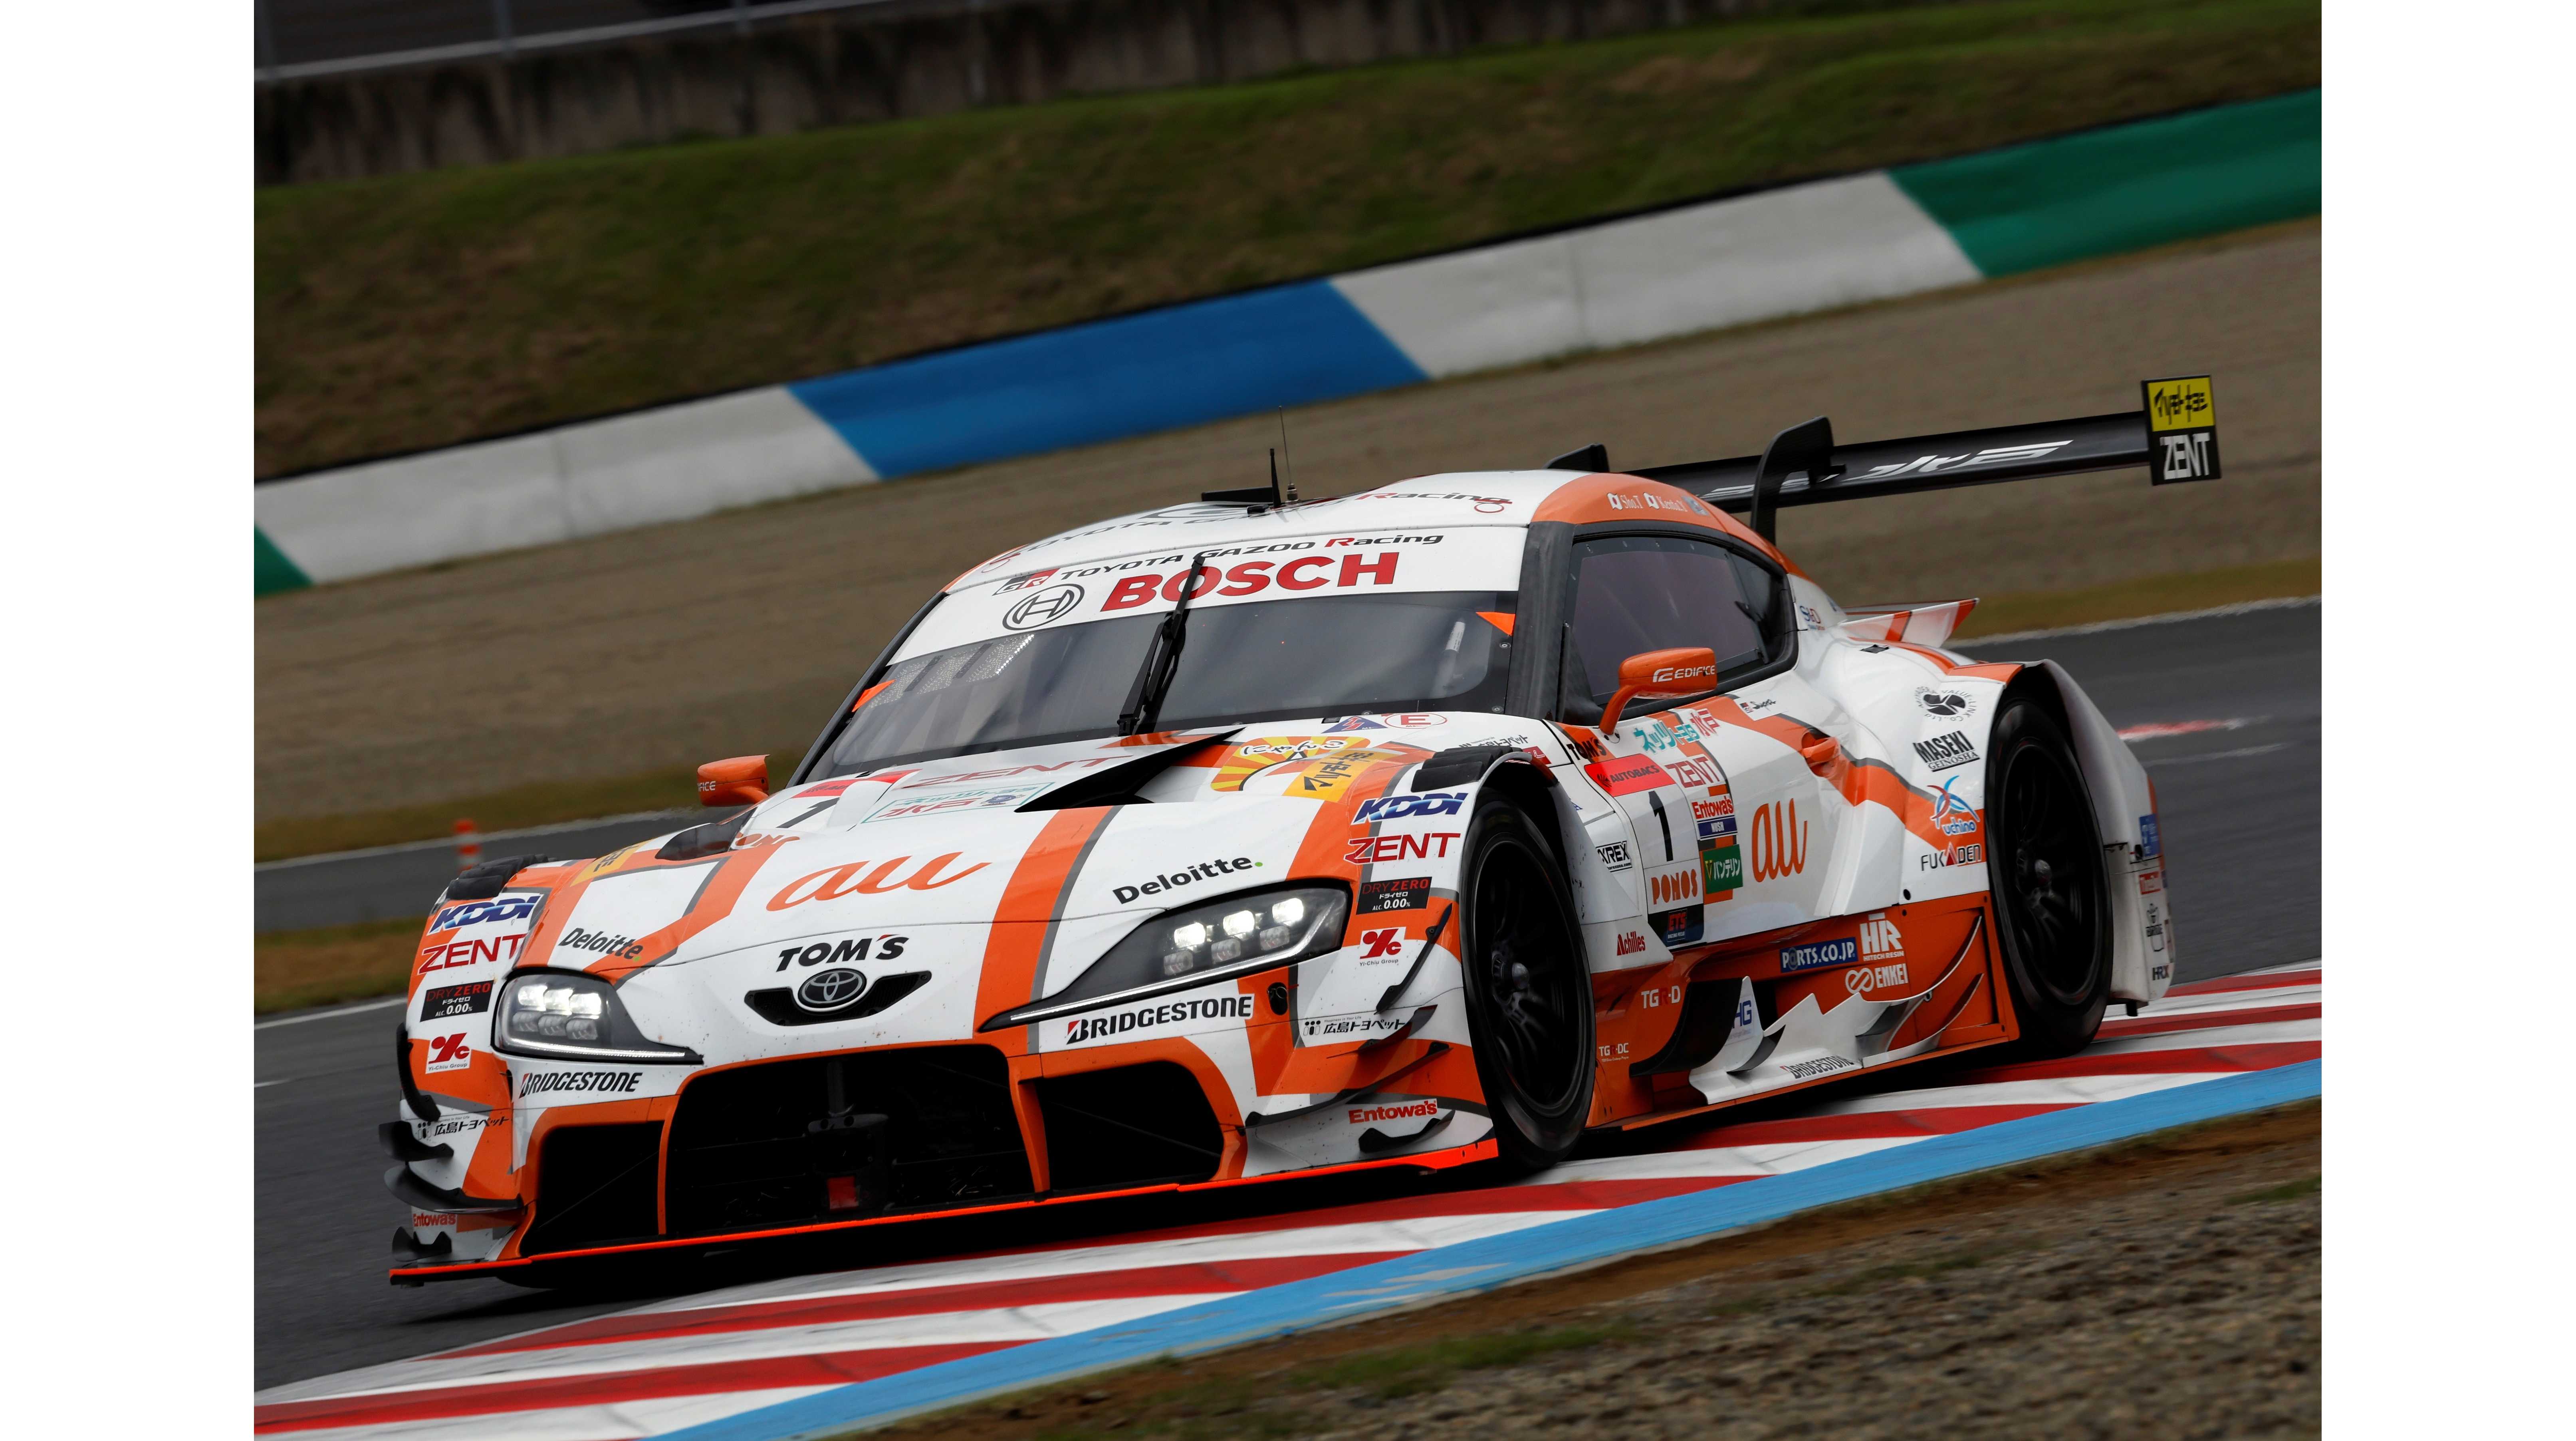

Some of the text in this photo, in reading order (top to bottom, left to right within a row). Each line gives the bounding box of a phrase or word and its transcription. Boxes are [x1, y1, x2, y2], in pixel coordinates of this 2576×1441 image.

[2160, 432, 2210, 480] ZENT
[1061, 534, 1444, 580] TOYOTA GAZOO Racing
[1100, 552, 1400, 612] BOSCH
[1674, 665, 1715, 679] EDIFICE
[1567, 737, 1606, 760] TOM'S
[1913, 731, 1974, 763] MASEKI
[902, 755, 1133, 789] ZENT
[1665, 757, 1720, 788] ZENT
[1928, 752, 1978, 769] GEINOSHA
[1610, 765, 1660, 783] AUTOBACS
[1354, 793, 1467, 823] KDDI
[1692, 795, 1733, 819] Entowa's
[1649, 791, 1673, 861] 1
[1943, 818, 1976, 834] uchino
[1345, 833, 1460, 864] ZENT
[1751, 798, 1807, 882] au
[766, 852, 992, 911] au
[1714, 858, 1740, 880] バンテリン
[1651, 869, 1697, 905] PONOS
[429, 896, 541, 933] KDDI
[1384, 898, 1410, 909] 0.00%
[418, 934, 527, 974] ZENT
[776, 934, 909, 972] TOM'S
[1617, 931, 1645, 955] Achilles
[1875, 963, 1908, 988] ENKEI
[442, 996, 471, 1005] ドライゼロ
[446, 1003, 472, 1015] 0.00%
[1066, 995, 1252, 1045] BRIDGESTONE
[1323, 1019, 1406, 1034] 広島トヨペット
[1779, 1055, 1854, 1079] BRIDGESTONE
[519, 1072, 642, 1099] BRIDGESTONE
[1348, 1101, 1437, 1124] Entowa's
[434, 1116, 509, 1136] 広島トヨペット
[413, 1212, 456, 1227] Entowa's
